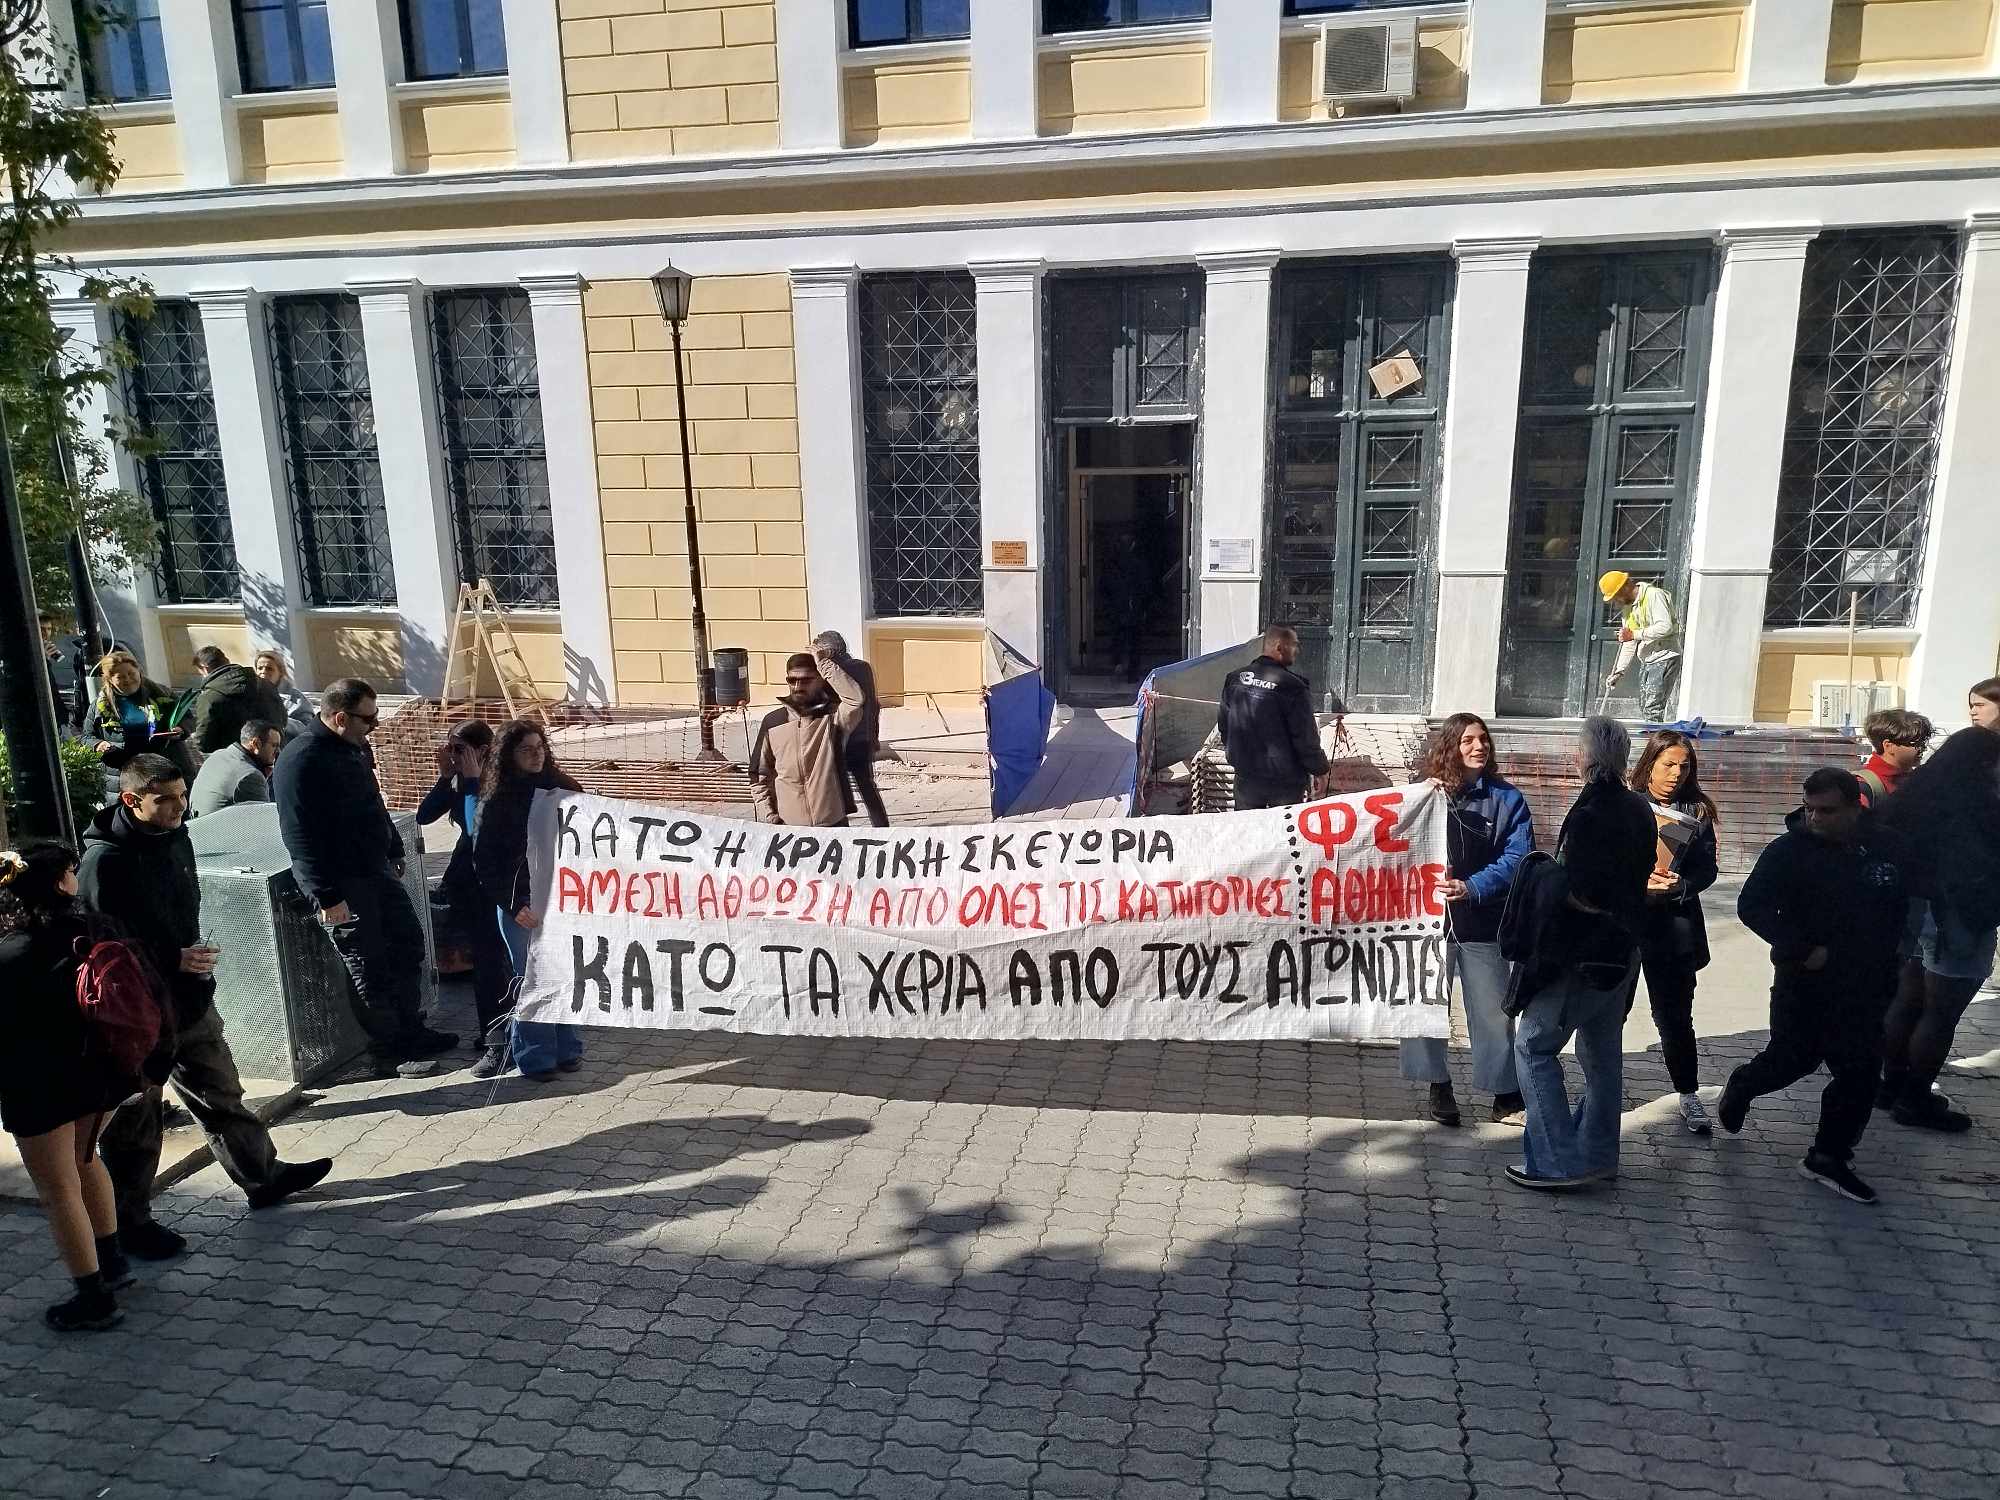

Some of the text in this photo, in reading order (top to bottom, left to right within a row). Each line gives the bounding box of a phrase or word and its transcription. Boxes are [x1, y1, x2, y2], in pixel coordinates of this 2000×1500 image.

[557, 805, 1175, 880] ΚΑΤΩ Η ΚΡΑΤΙΚΗ ΣΚΕΥΩΡΙΑ
[1297, 792, 1410, 861] ΦΣ
[558, 867, 1293, 931] ΑΜΕΣΗ ΑΘΩΩΣΗ ΑΠΟ ΟΛΕΣ ΤΙΣ ΚΑΤΗΓΟΡΙΕΣ
[1311, 863, 1446, 925] ΑΘΗΝΑΣ
[572, 933, 1449, 1019] ΚΑΤΩ ΤΑ ΧΕΡΙΑ ΑΠΟ ΤΟΥΣ ΑΓΩΝΙΣΤΕΣ
